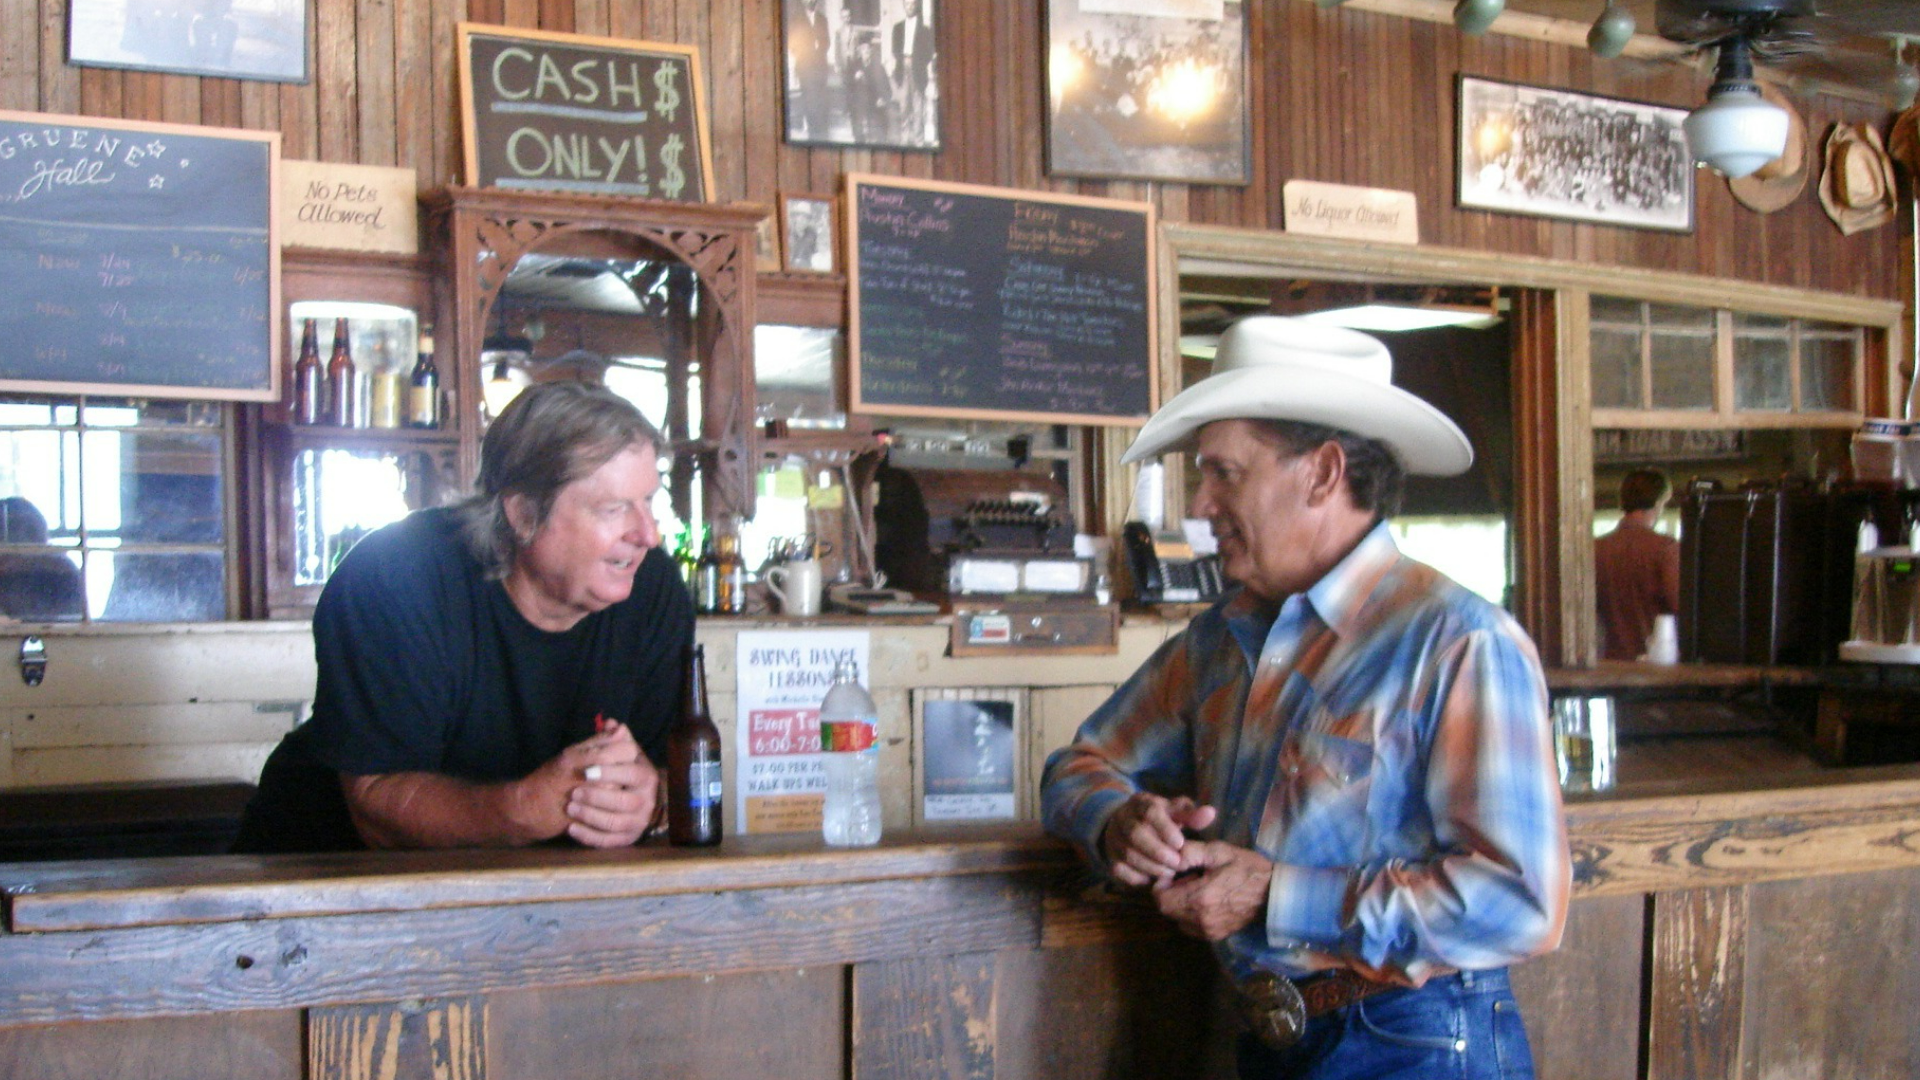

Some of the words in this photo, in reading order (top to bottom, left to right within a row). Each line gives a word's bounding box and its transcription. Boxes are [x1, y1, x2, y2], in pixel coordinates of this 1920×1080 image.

[492, 47, 642, 107] CASH
[0, 128, 146, 169] GRUENE
[506, 126, 648, 184] ONLY!
[19, 157, 116, 200] Hall
[305, 180, 330, 200] No
[333, 182, 379, 203] Pets
[297, 201, 387, 230] Allowed
[749, 647, 801, 668] SWING
[753, 713, 794, 737] Every
[755, 736, 821, 754] 6:00-7:0
[806, 777, 829, 790] WEL
